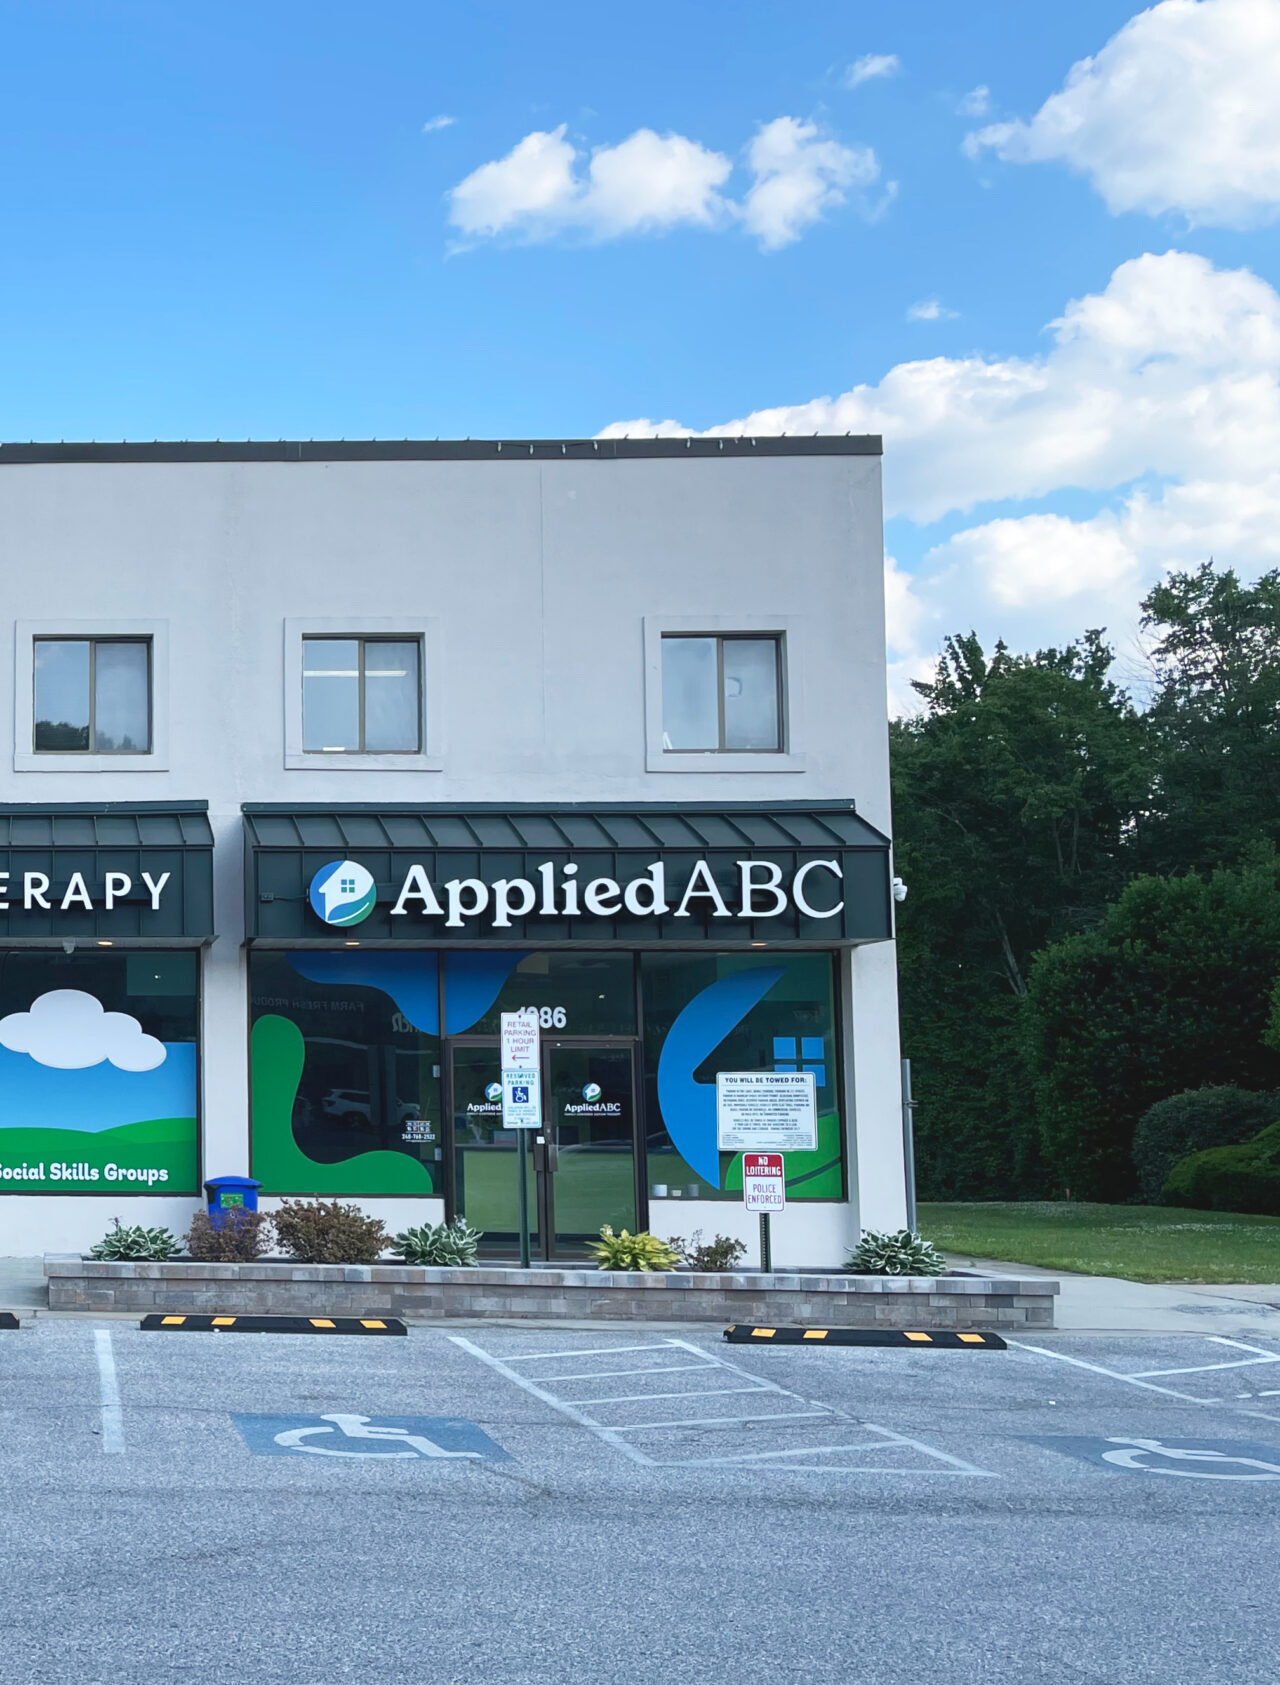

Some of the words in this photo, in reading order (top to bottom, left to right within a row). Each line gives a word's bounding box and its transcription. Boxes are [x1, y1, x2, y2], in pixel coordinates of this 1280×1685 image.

[758, 1156, 769, 1166] NO
[49, 1162, 100, 1182] Skills
[104, 1162, 169, 1186] Groups
[746, 1166, 781, 1176] LOITERING
[752, 1183, 777, 1194] POLICE
[747, 1194, 782, 1205] ENFORCED
